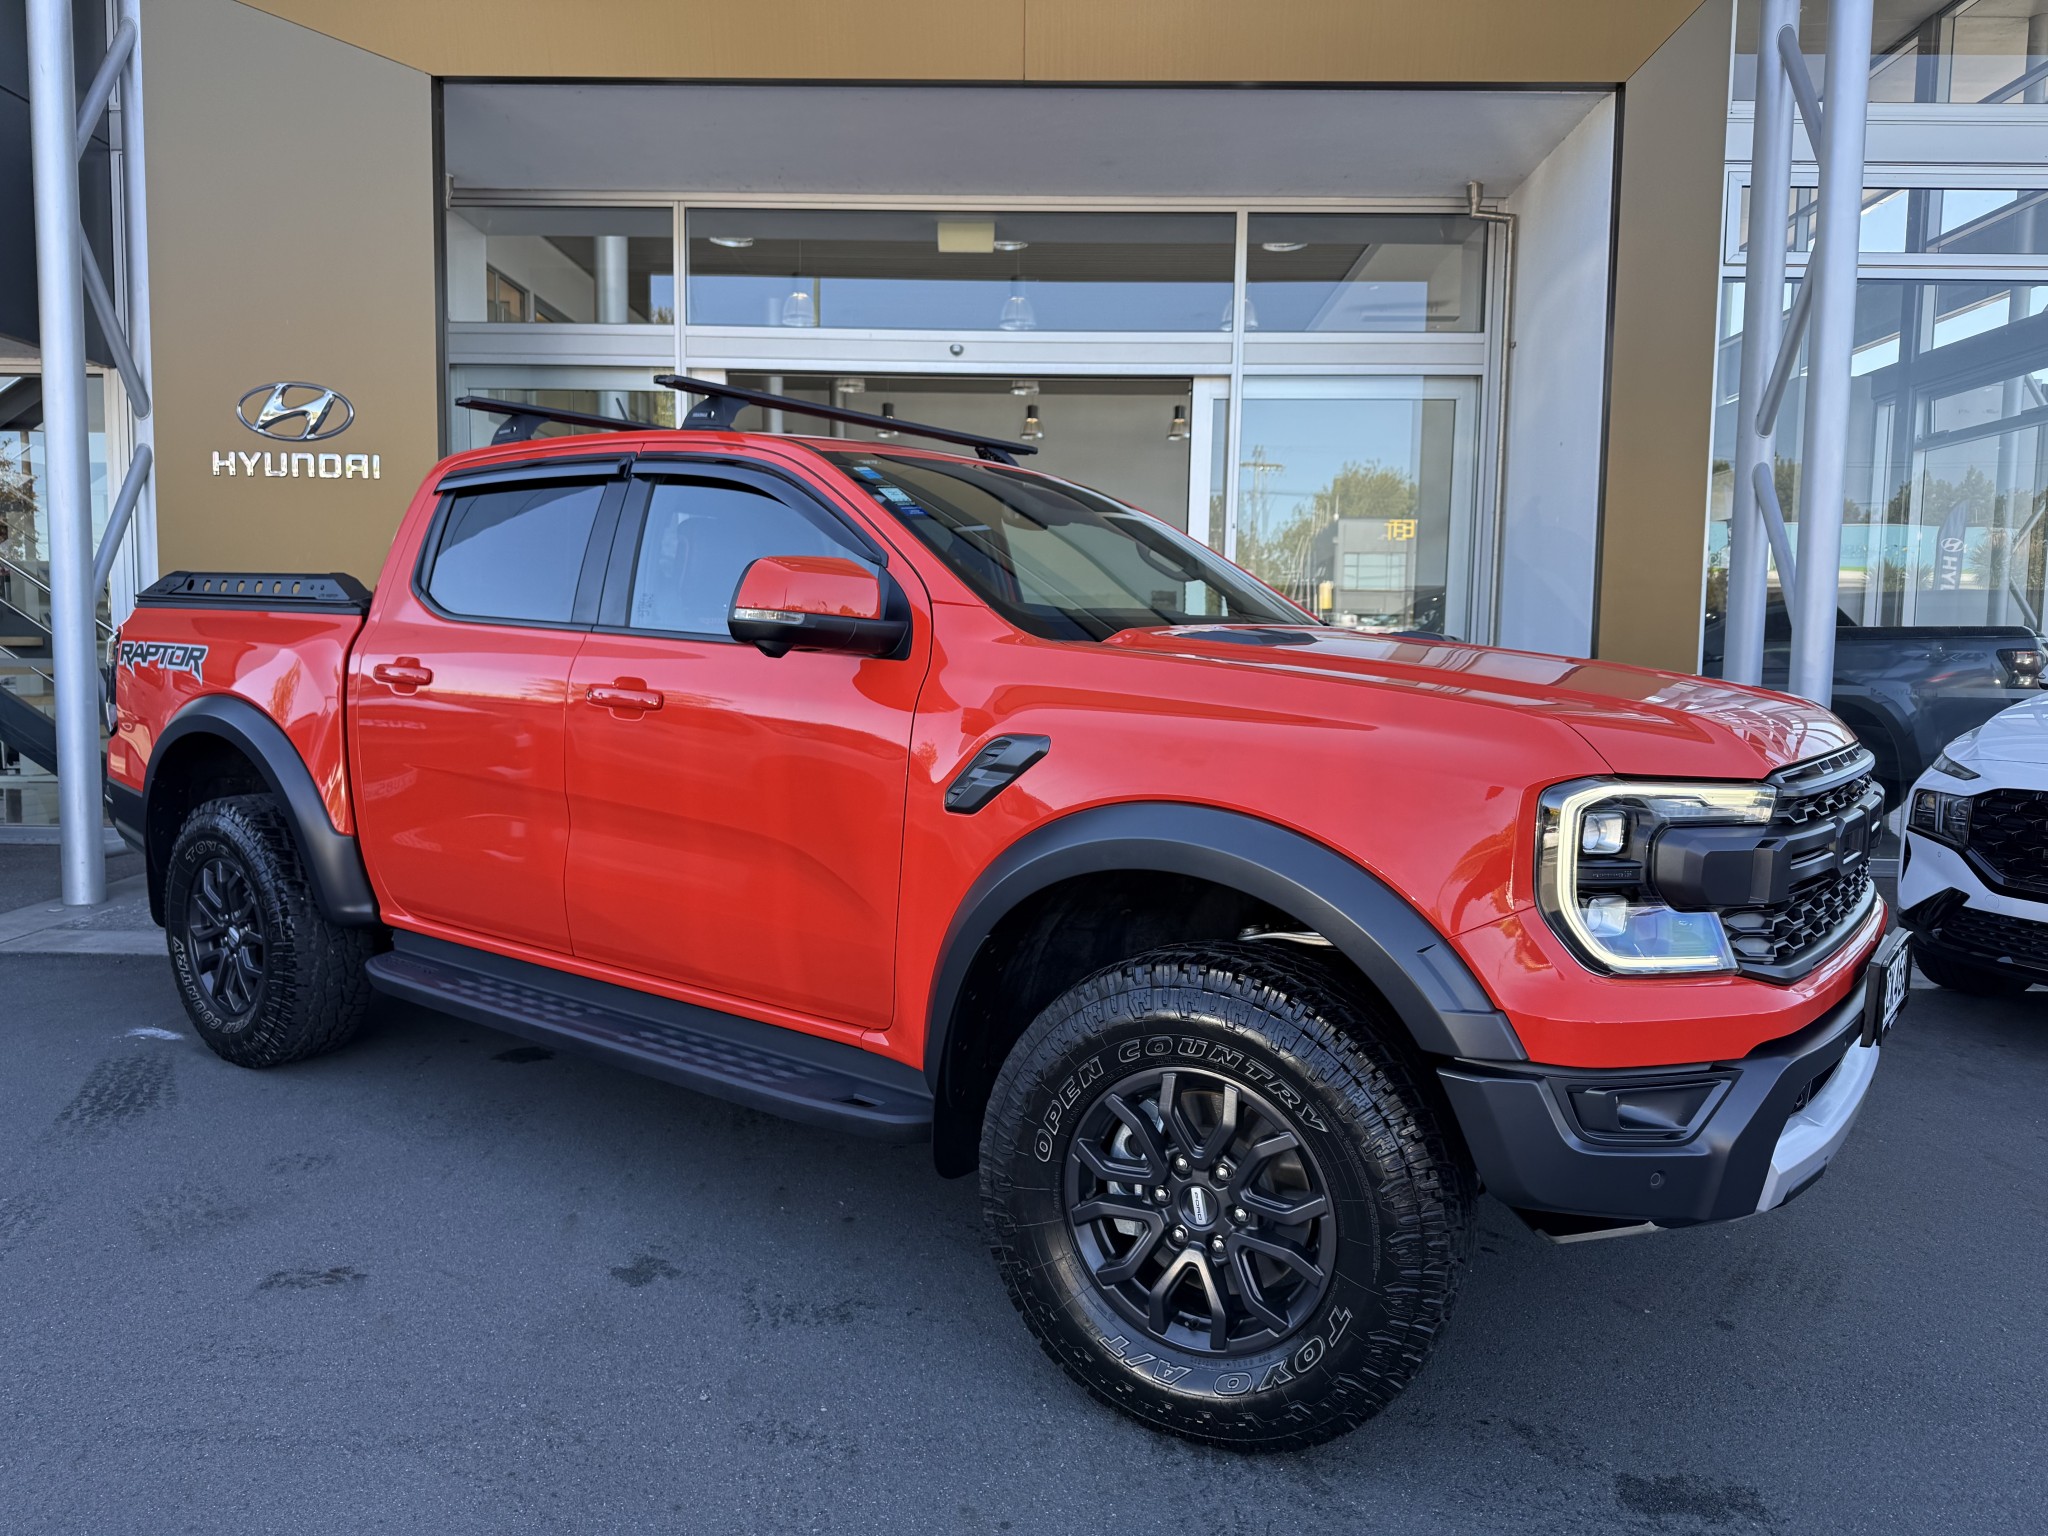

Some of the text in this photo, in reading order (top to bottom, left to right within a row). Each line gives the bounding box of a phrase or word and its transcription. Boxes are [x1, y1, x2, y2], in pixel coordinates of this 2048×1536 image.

[212, 450, 381, 480] HYUNDAI
[119, 640, 209, 687] RAPTOR
[1034, 1055, 1104, 1162] OPEN
[1118, 1035, 1330, 1133] COUNTRY
[1098, 1304, 1353, 1396] TOYO A/T
